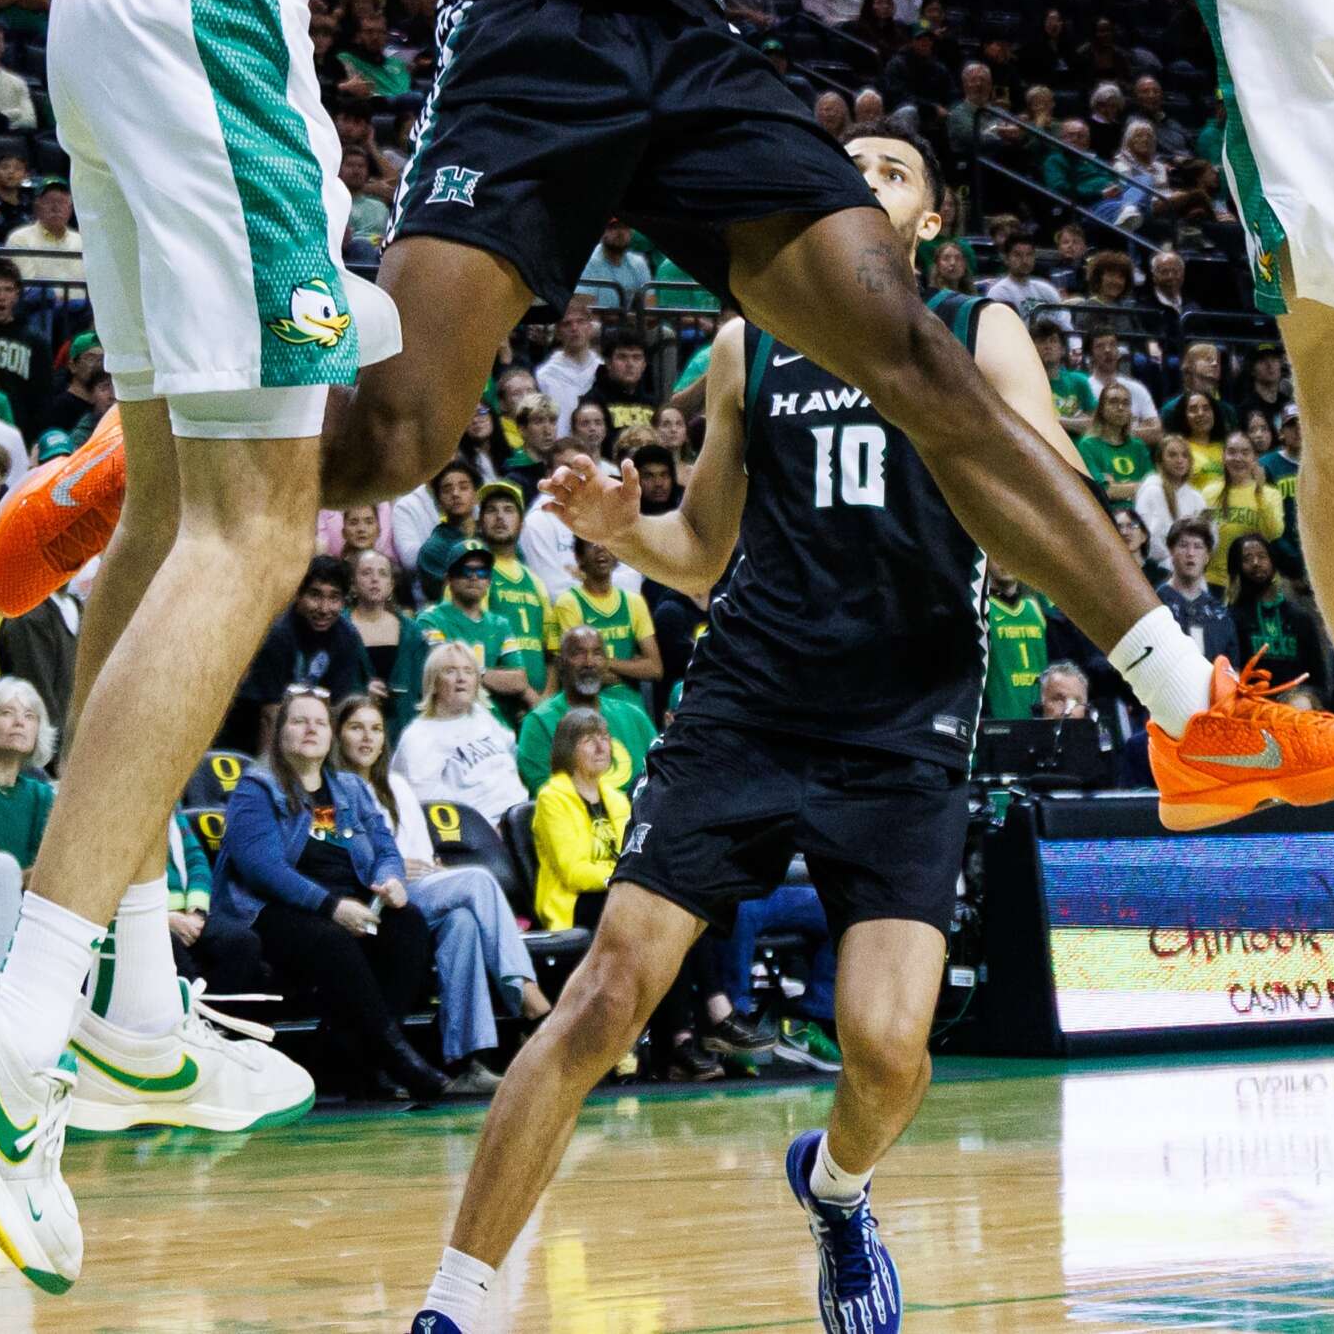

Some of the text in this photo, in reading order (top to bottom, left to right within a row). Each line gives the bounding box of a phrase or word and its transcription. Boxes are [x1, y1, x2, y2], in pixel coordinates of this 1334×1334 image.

[425, 165, 485, 207] H
[770, 387, 872, 416] HAW
[810, 425, 887, 508] 10
[1228, 979, 1322, 1015] CASINO
